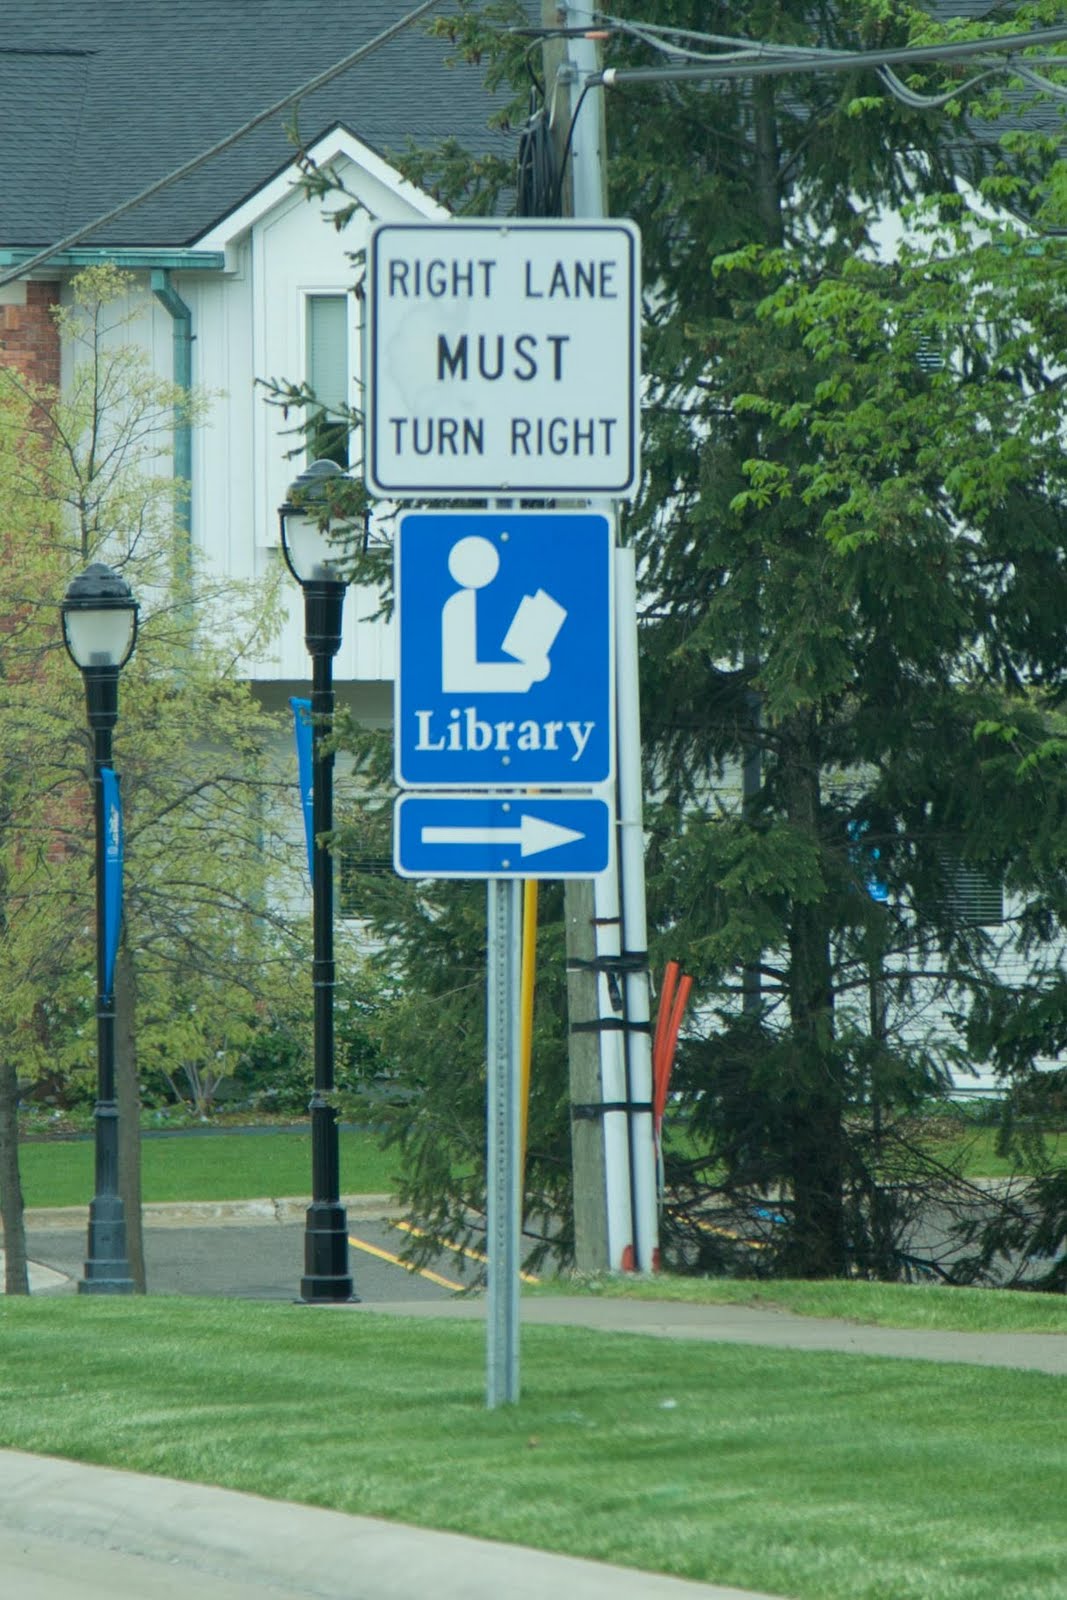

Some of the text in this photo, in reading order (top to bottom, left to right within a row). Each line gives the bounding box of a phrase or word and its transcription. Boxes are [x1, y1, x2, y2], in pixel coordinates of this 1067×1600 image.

[389, 260, 617, 298] RIGHT LANE
[437, 334, 570, 381] MUST
[389, 417, 617, 456] TURN RIGHT
[415, 707, 595, 762] Library
